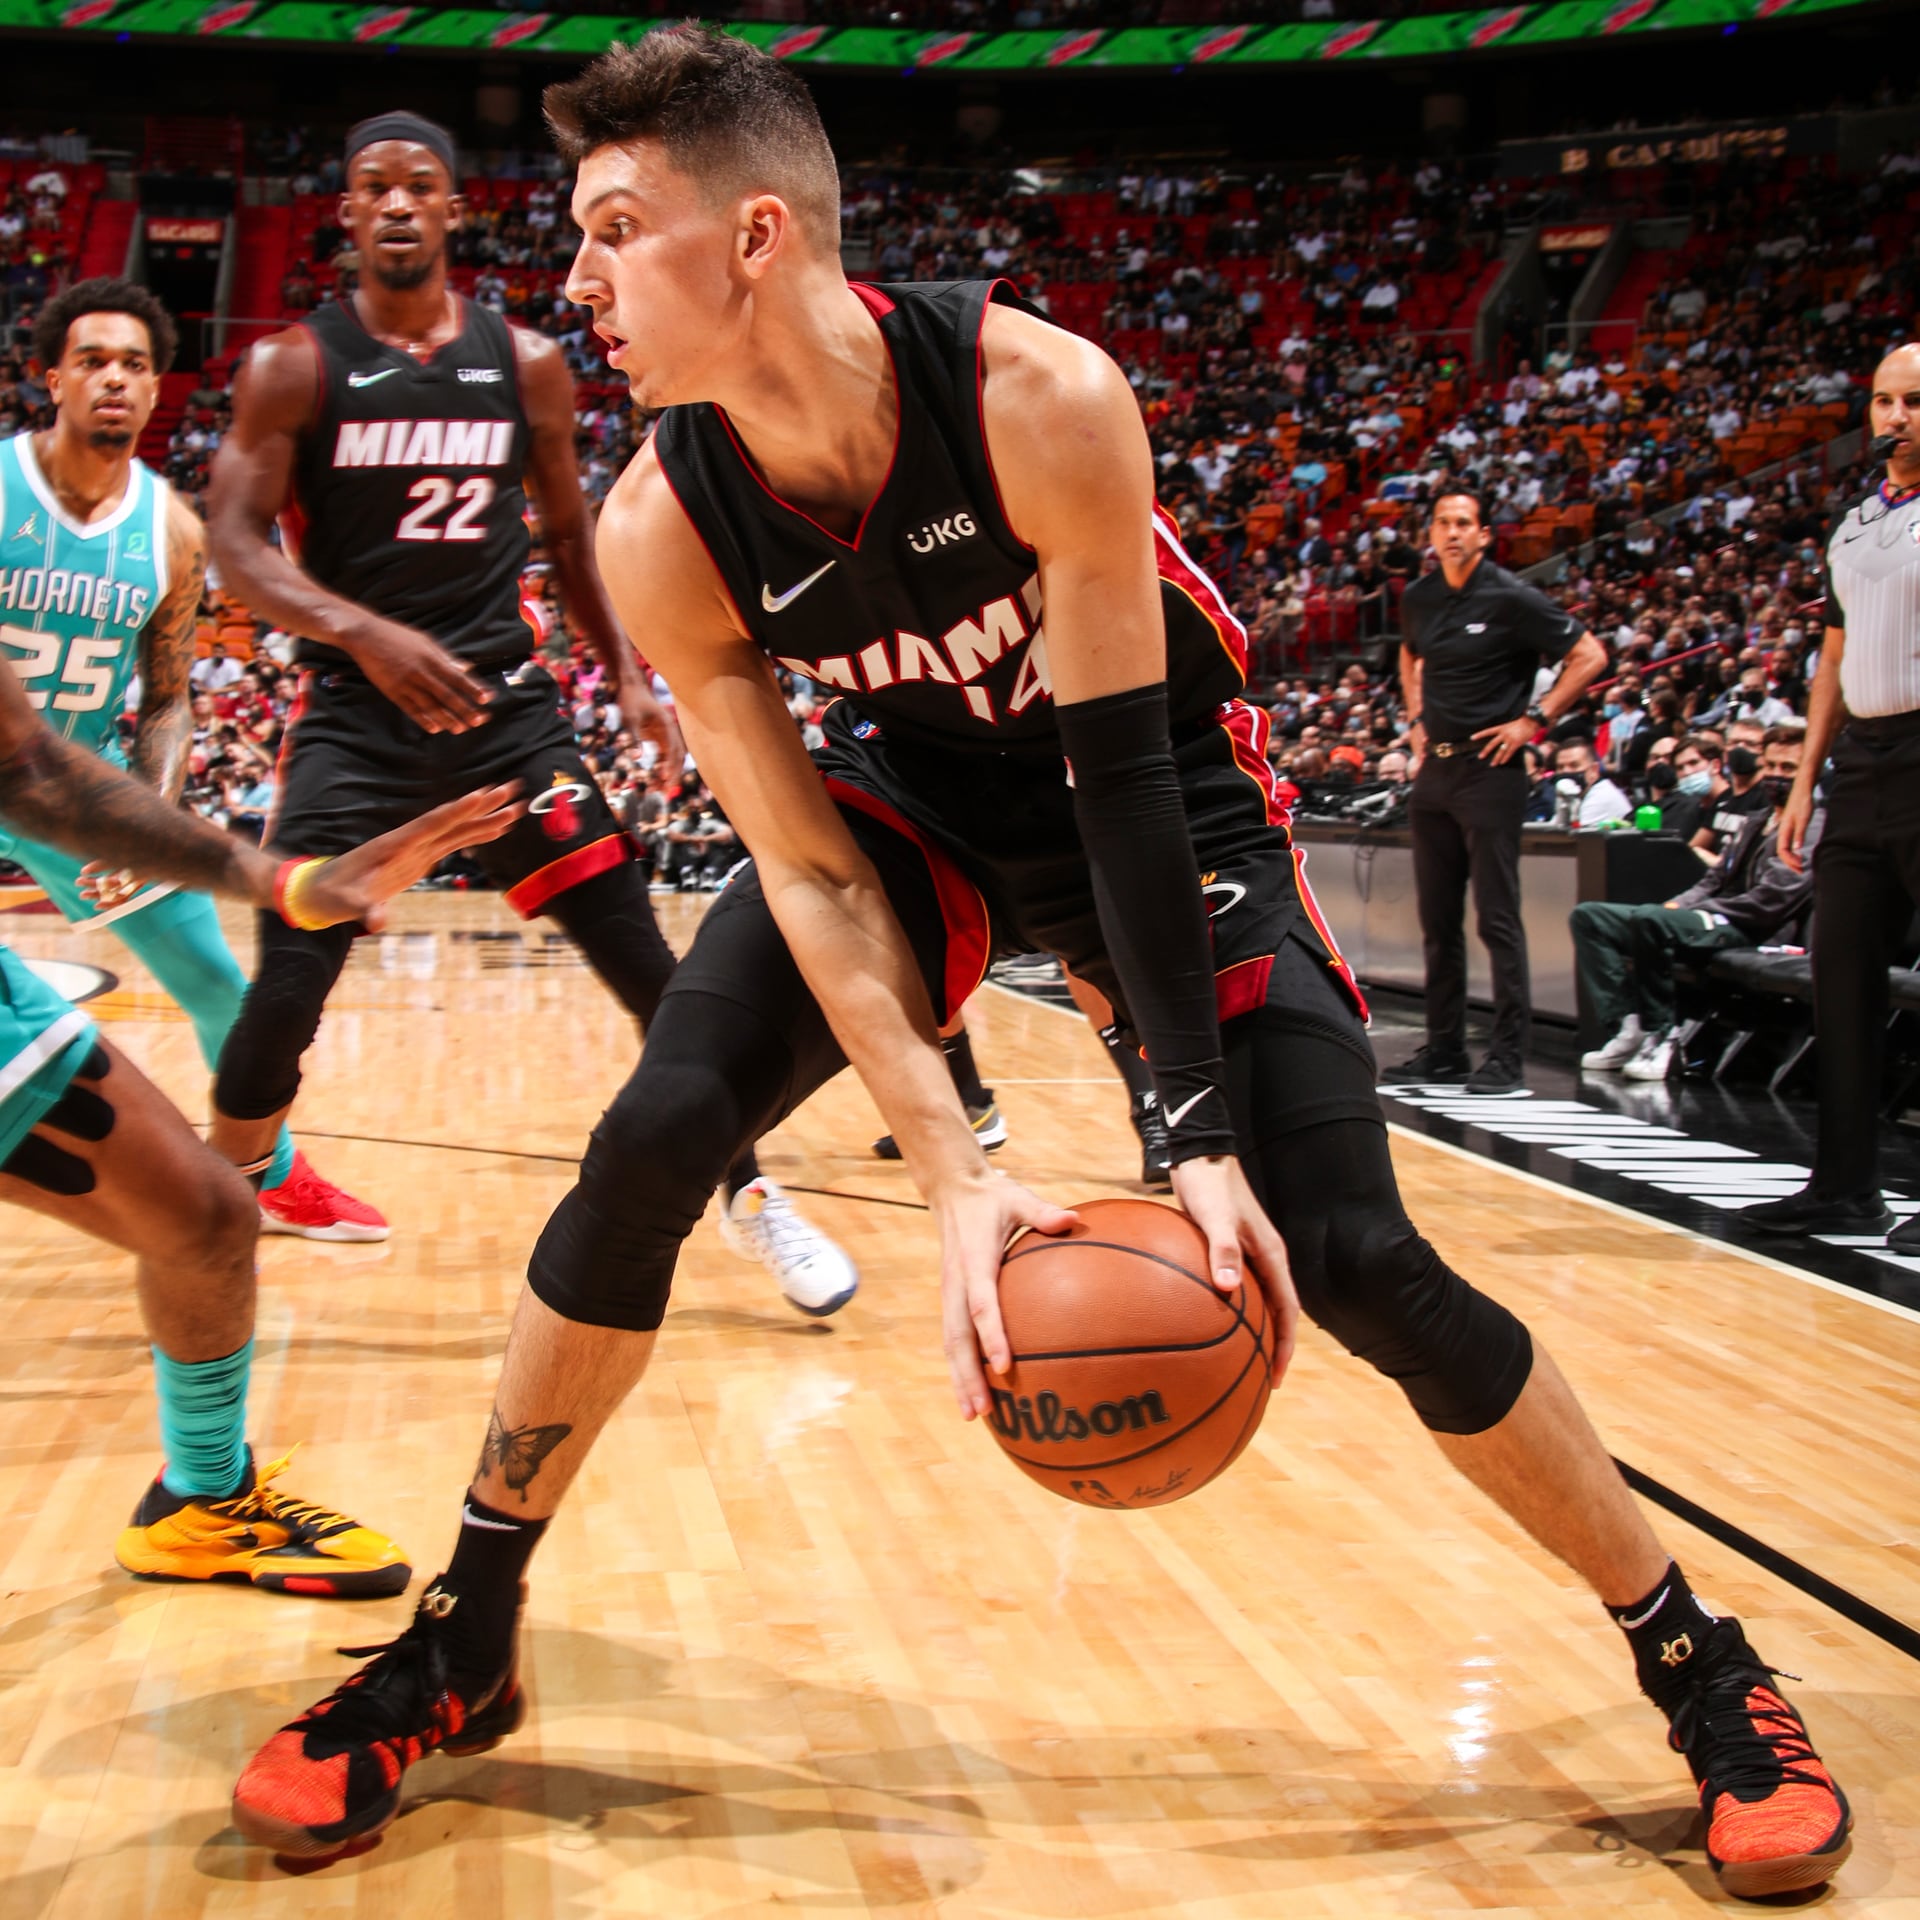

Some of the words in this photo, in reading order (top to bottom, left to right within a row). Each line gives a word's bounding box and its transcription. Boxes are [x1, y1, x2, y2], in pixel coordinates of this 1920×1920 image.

[332, 418, 516, 468] MIAMI
[393, 474, 497, 542] 22
[0, 622, 123, 713] 25
